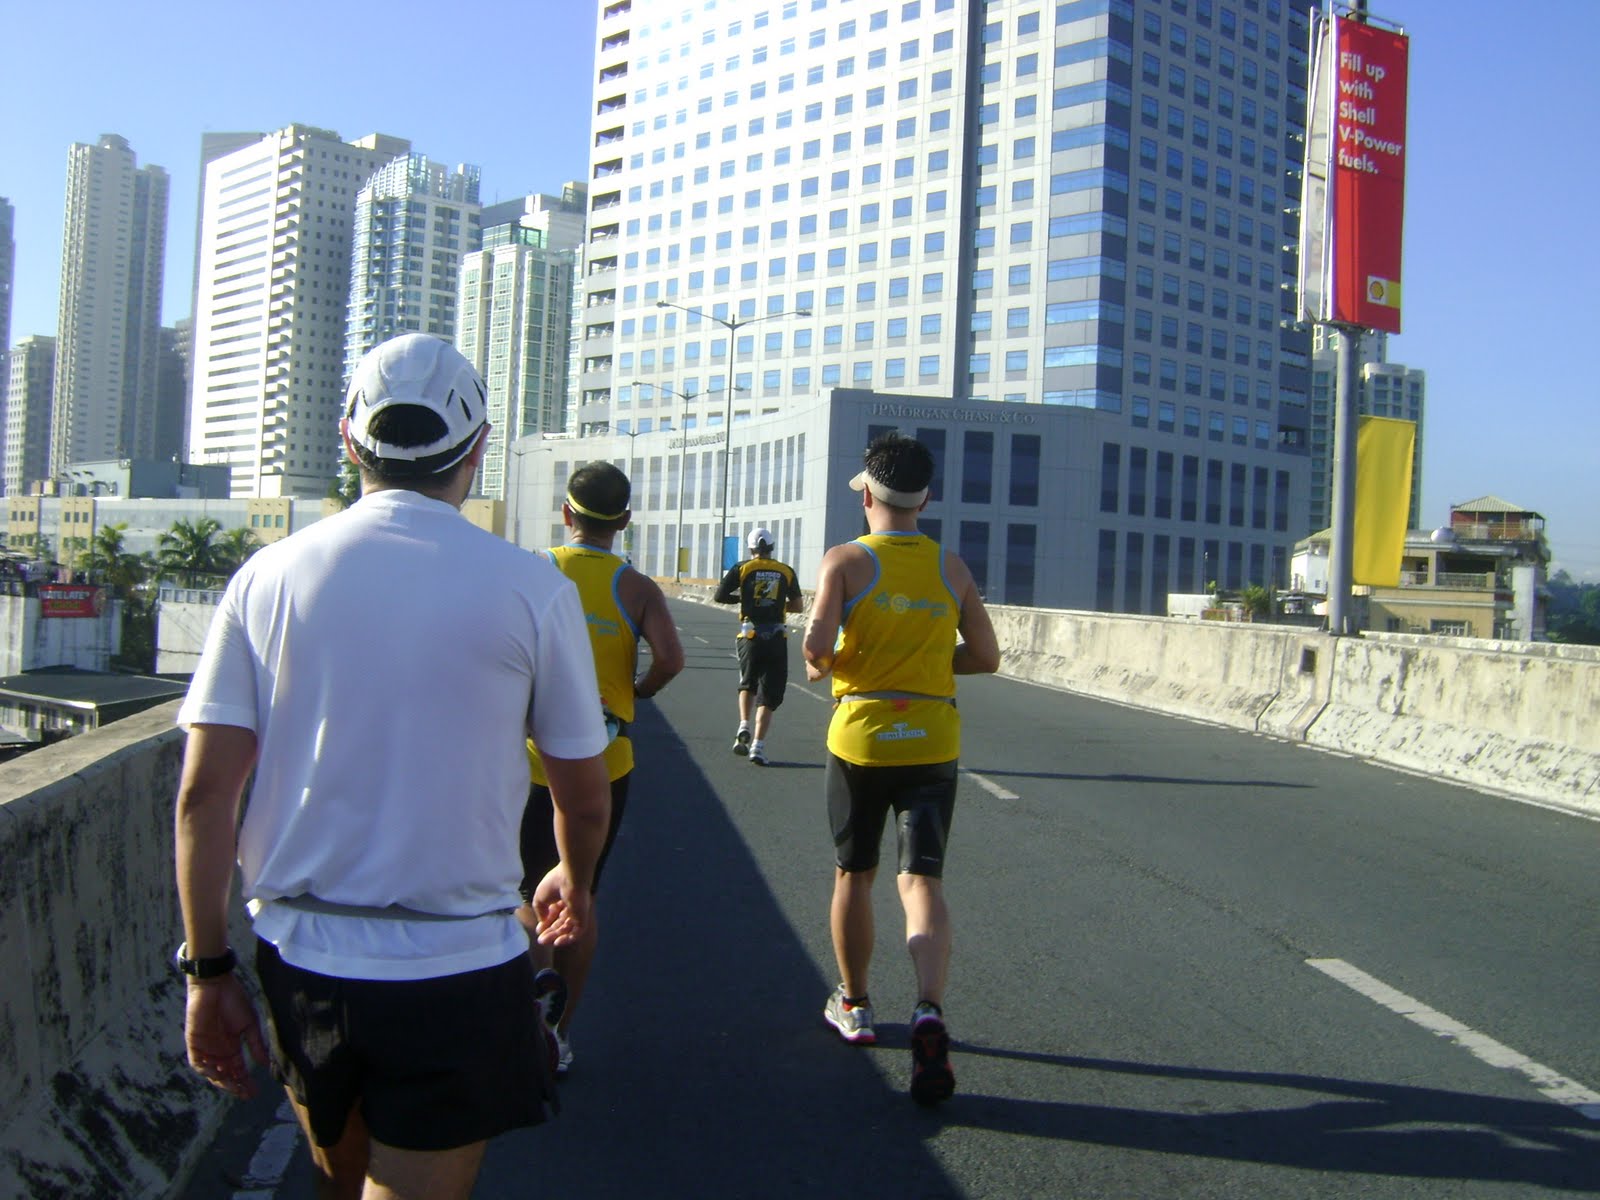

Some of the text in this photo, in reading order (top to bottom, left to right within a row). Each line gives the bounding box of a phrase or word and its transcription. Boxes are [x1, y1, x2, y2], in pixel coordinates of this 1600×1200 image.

[1340, 51, 1385, 82] Fill up
[1340, 79, 1373, 100] with
[1340, 101, 1375, 125] Shell
[1339, 124, 1402, 156] V-Power
[1338, 148, 1379, 174] fuels.
[953, 408, 994, 423] CHASE
[1000, 411, 1010, 424] &
